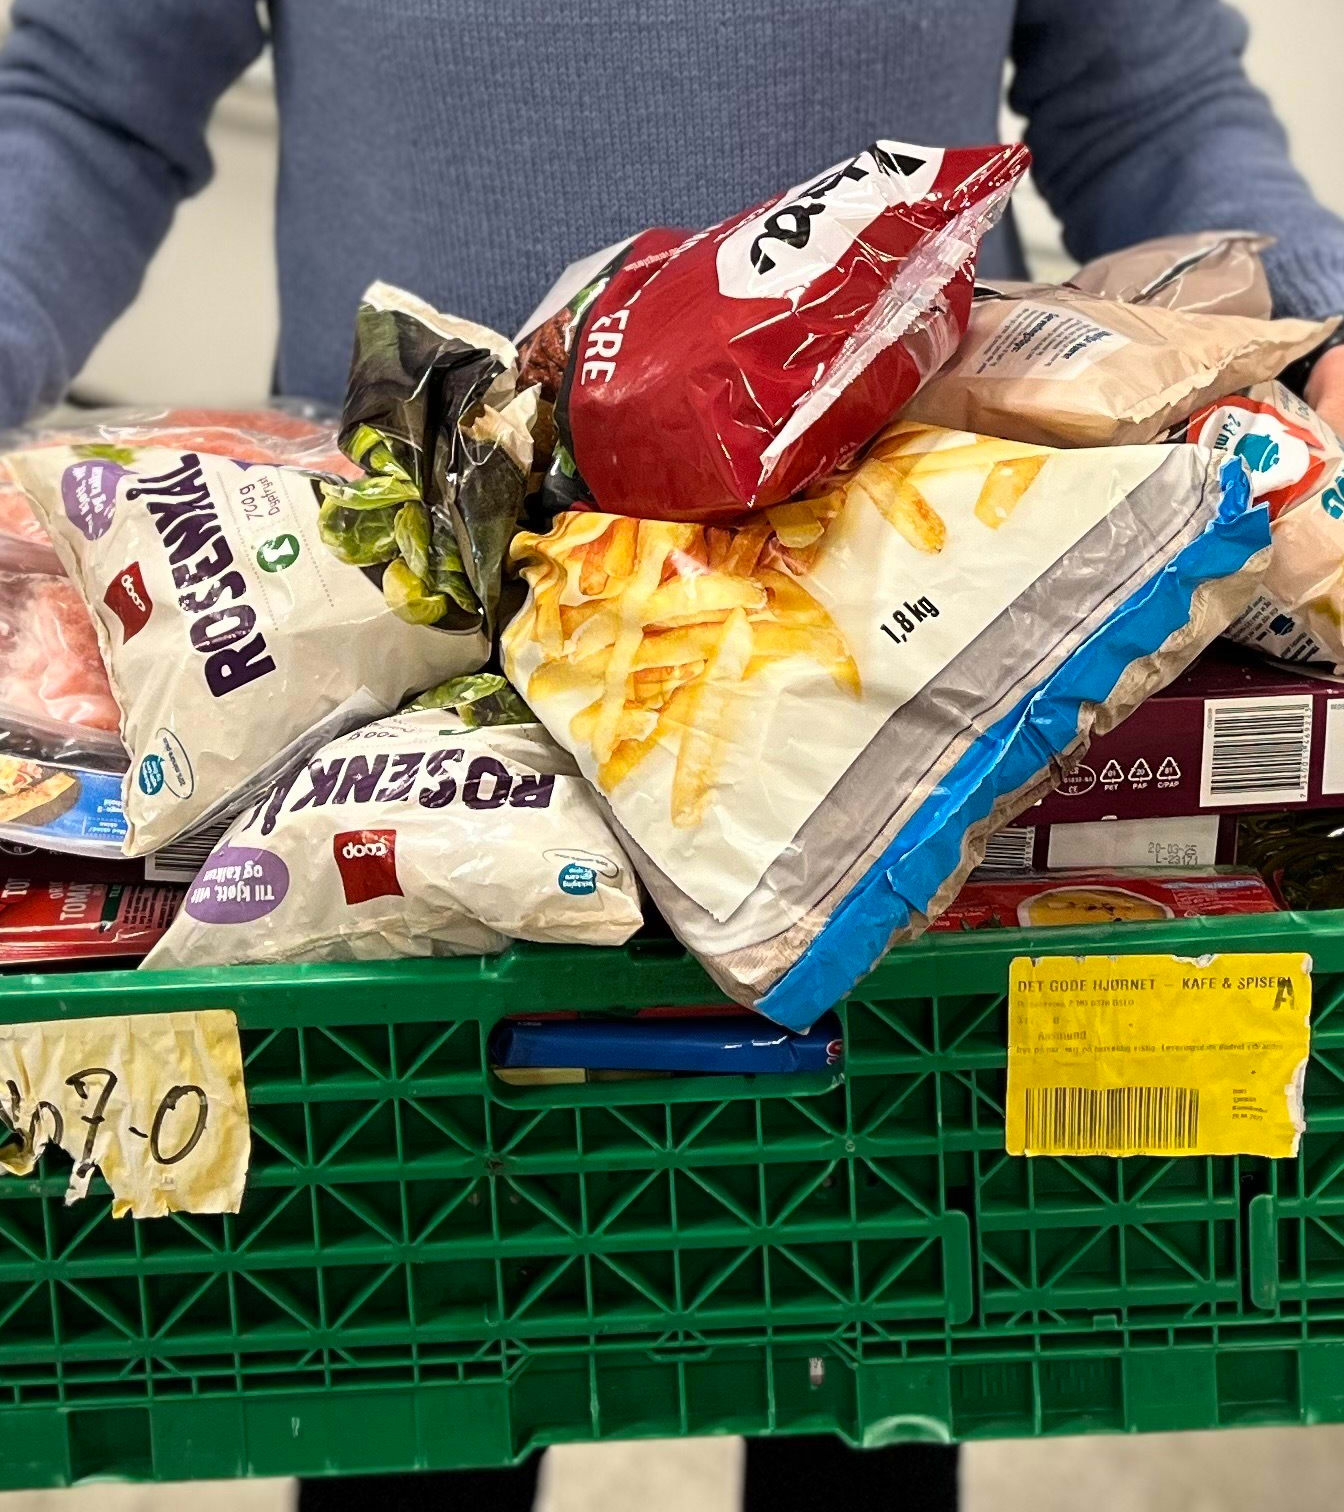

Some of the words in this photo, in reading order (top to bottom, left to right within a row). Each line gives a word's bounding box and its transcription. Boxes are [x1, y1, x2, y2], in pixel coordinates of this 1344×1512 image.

[121, 573, 146, 613] coop
[126, 453, 276, 697] ROSENKÅL
[881, 607, 917, 644] 1,8
[905, 595, 940, 625] kg
[243, 860, 263, 879] og
[342, 841, 391, 860] coop
[59, 882, 91, 921] TOMA
[1017, 980, 1044, 993] DET
[1049, 979, 1087, 993] GODE
[1093, 978, 1156, 992] HJØRNET
[1182, 977, 1217, 990] KAFE
[1222, 977, 1232, 990] &
